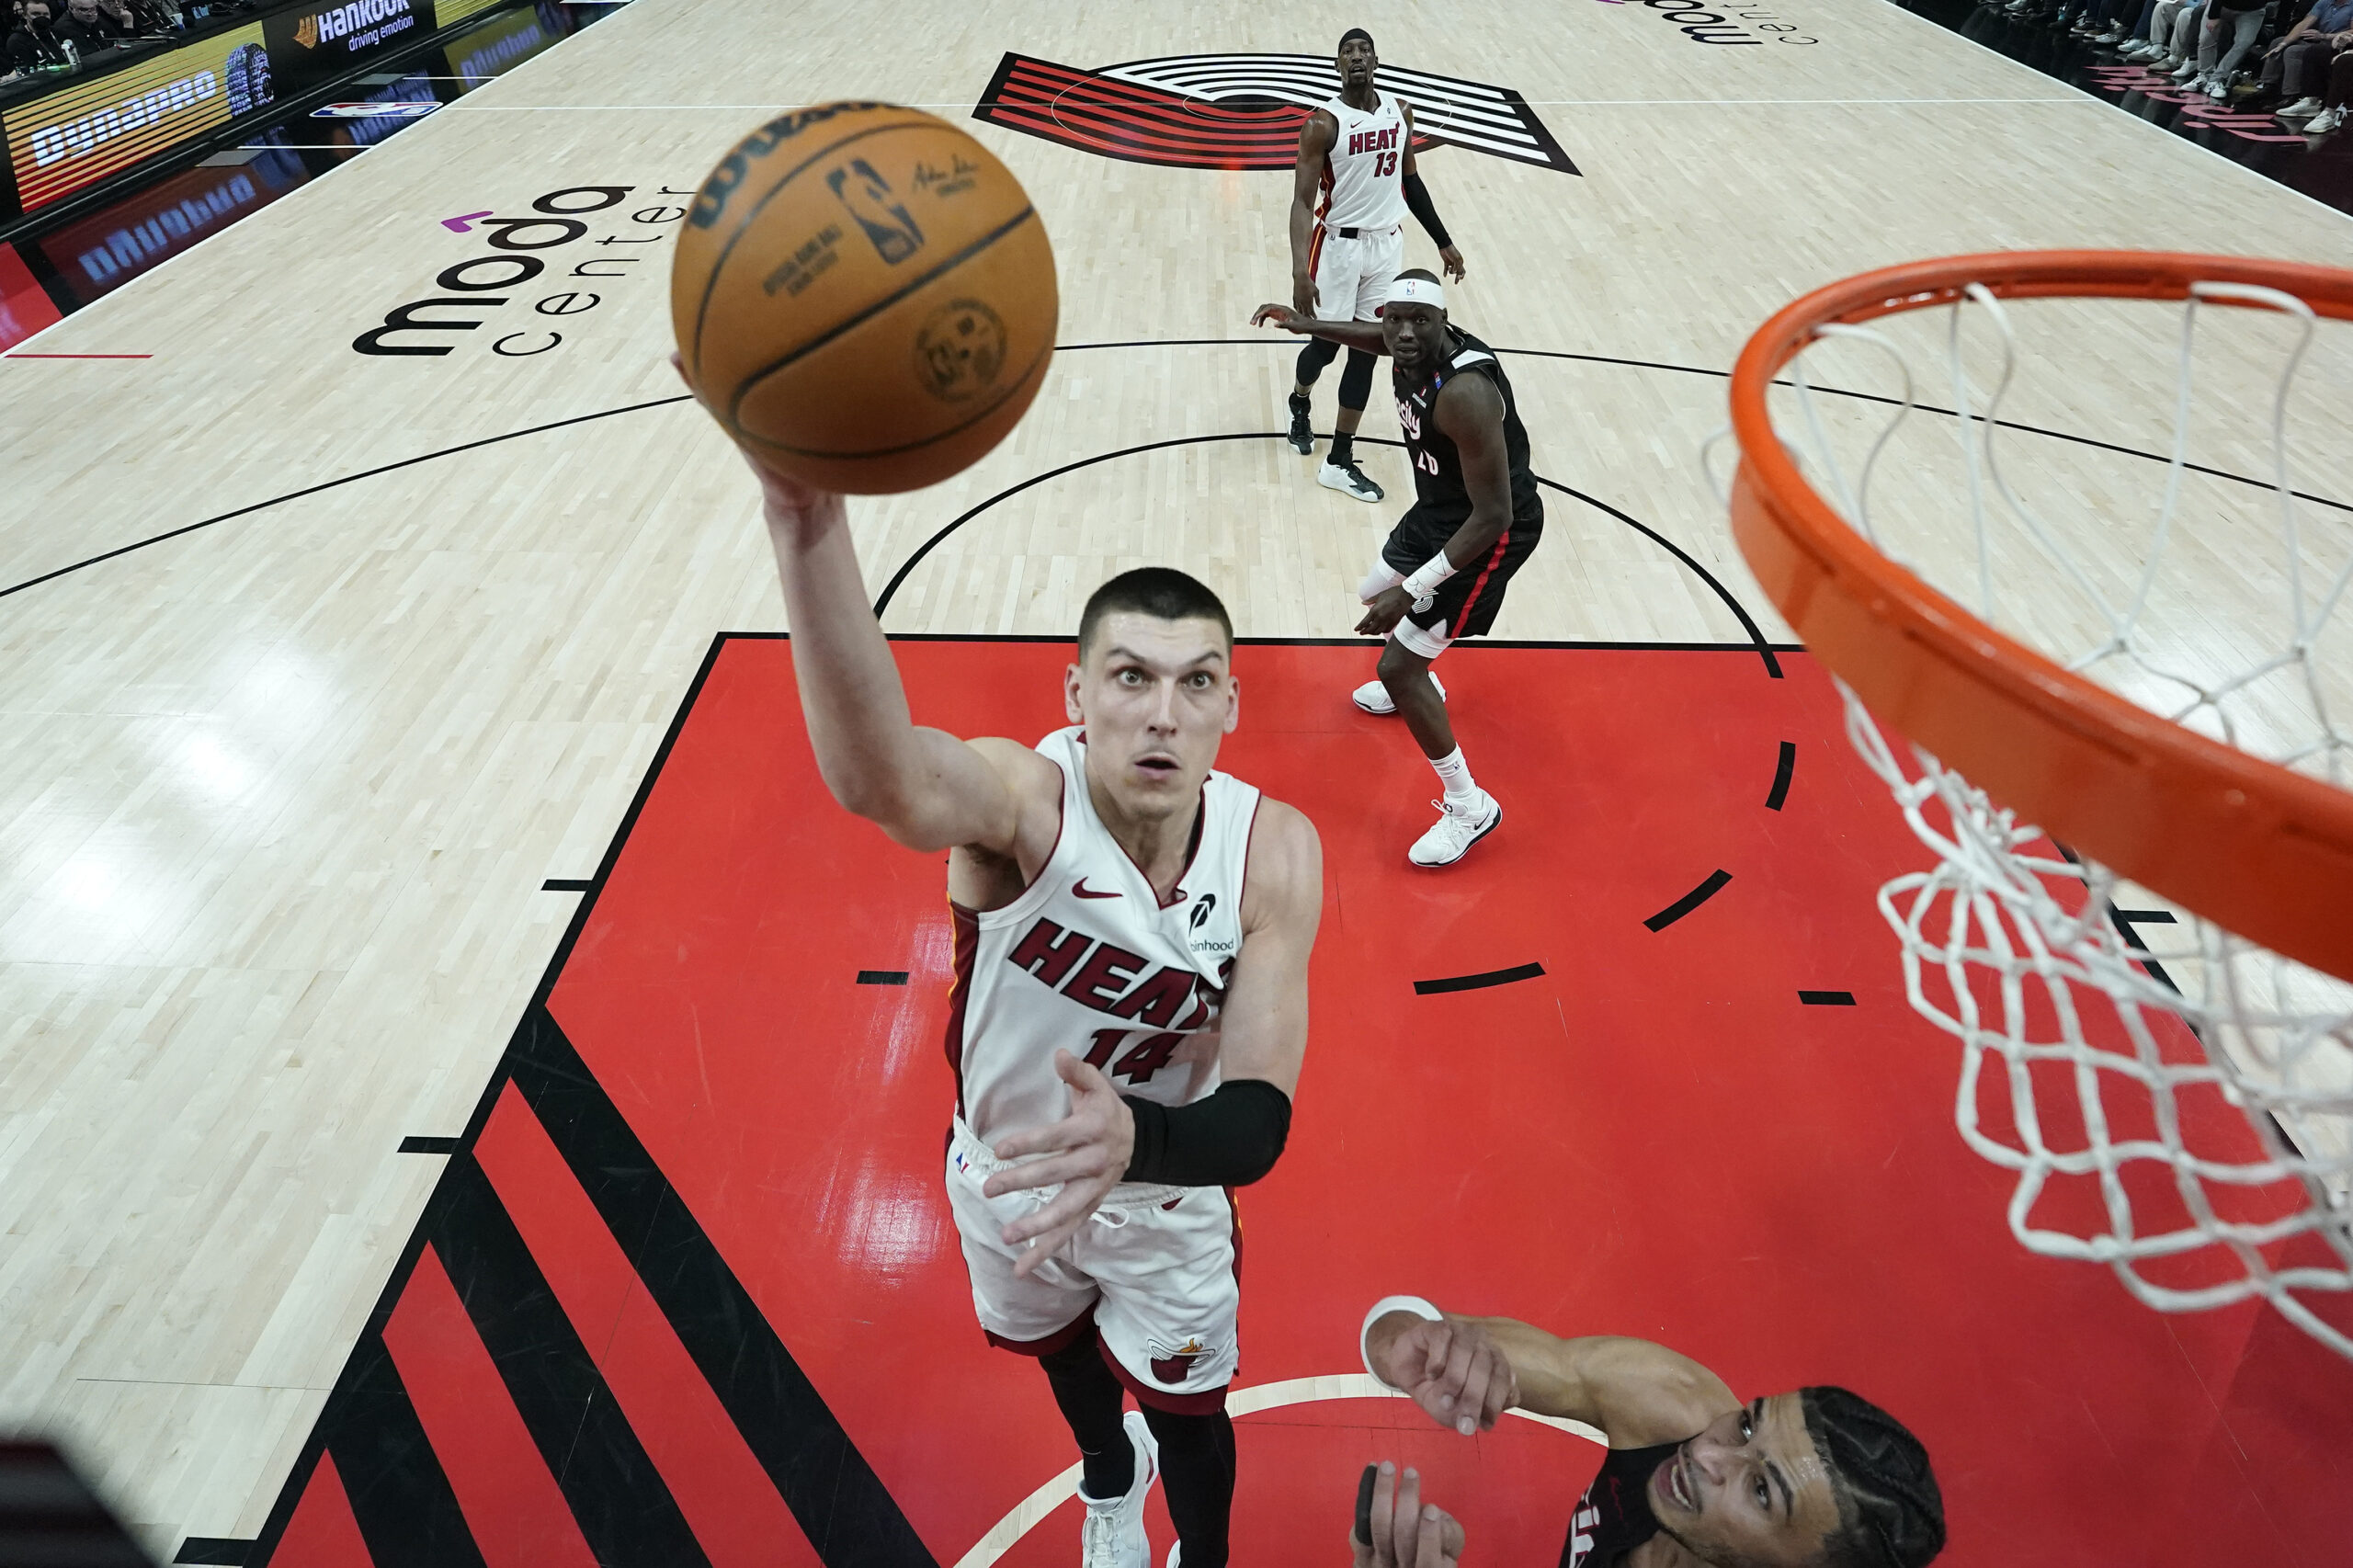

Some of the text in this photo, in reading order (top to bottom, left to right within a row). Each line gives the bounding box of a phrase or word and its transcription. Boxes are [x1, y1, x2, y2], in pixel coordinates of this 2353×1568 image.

[348, 15, 414, 51] driving emotion
[1623, 0, 1765, 45] mod
[1720, 4, 1819, 45] cent
[1348, 121, 1400, 156] HEAT
[2181, 104, 2310, 142] rip
[1374, 151, 1398, 177] 13
[352, 186, 637, 356] moda
[492, 186, 697, 356] center
[1081, 1028, 1187, 1085] 14
